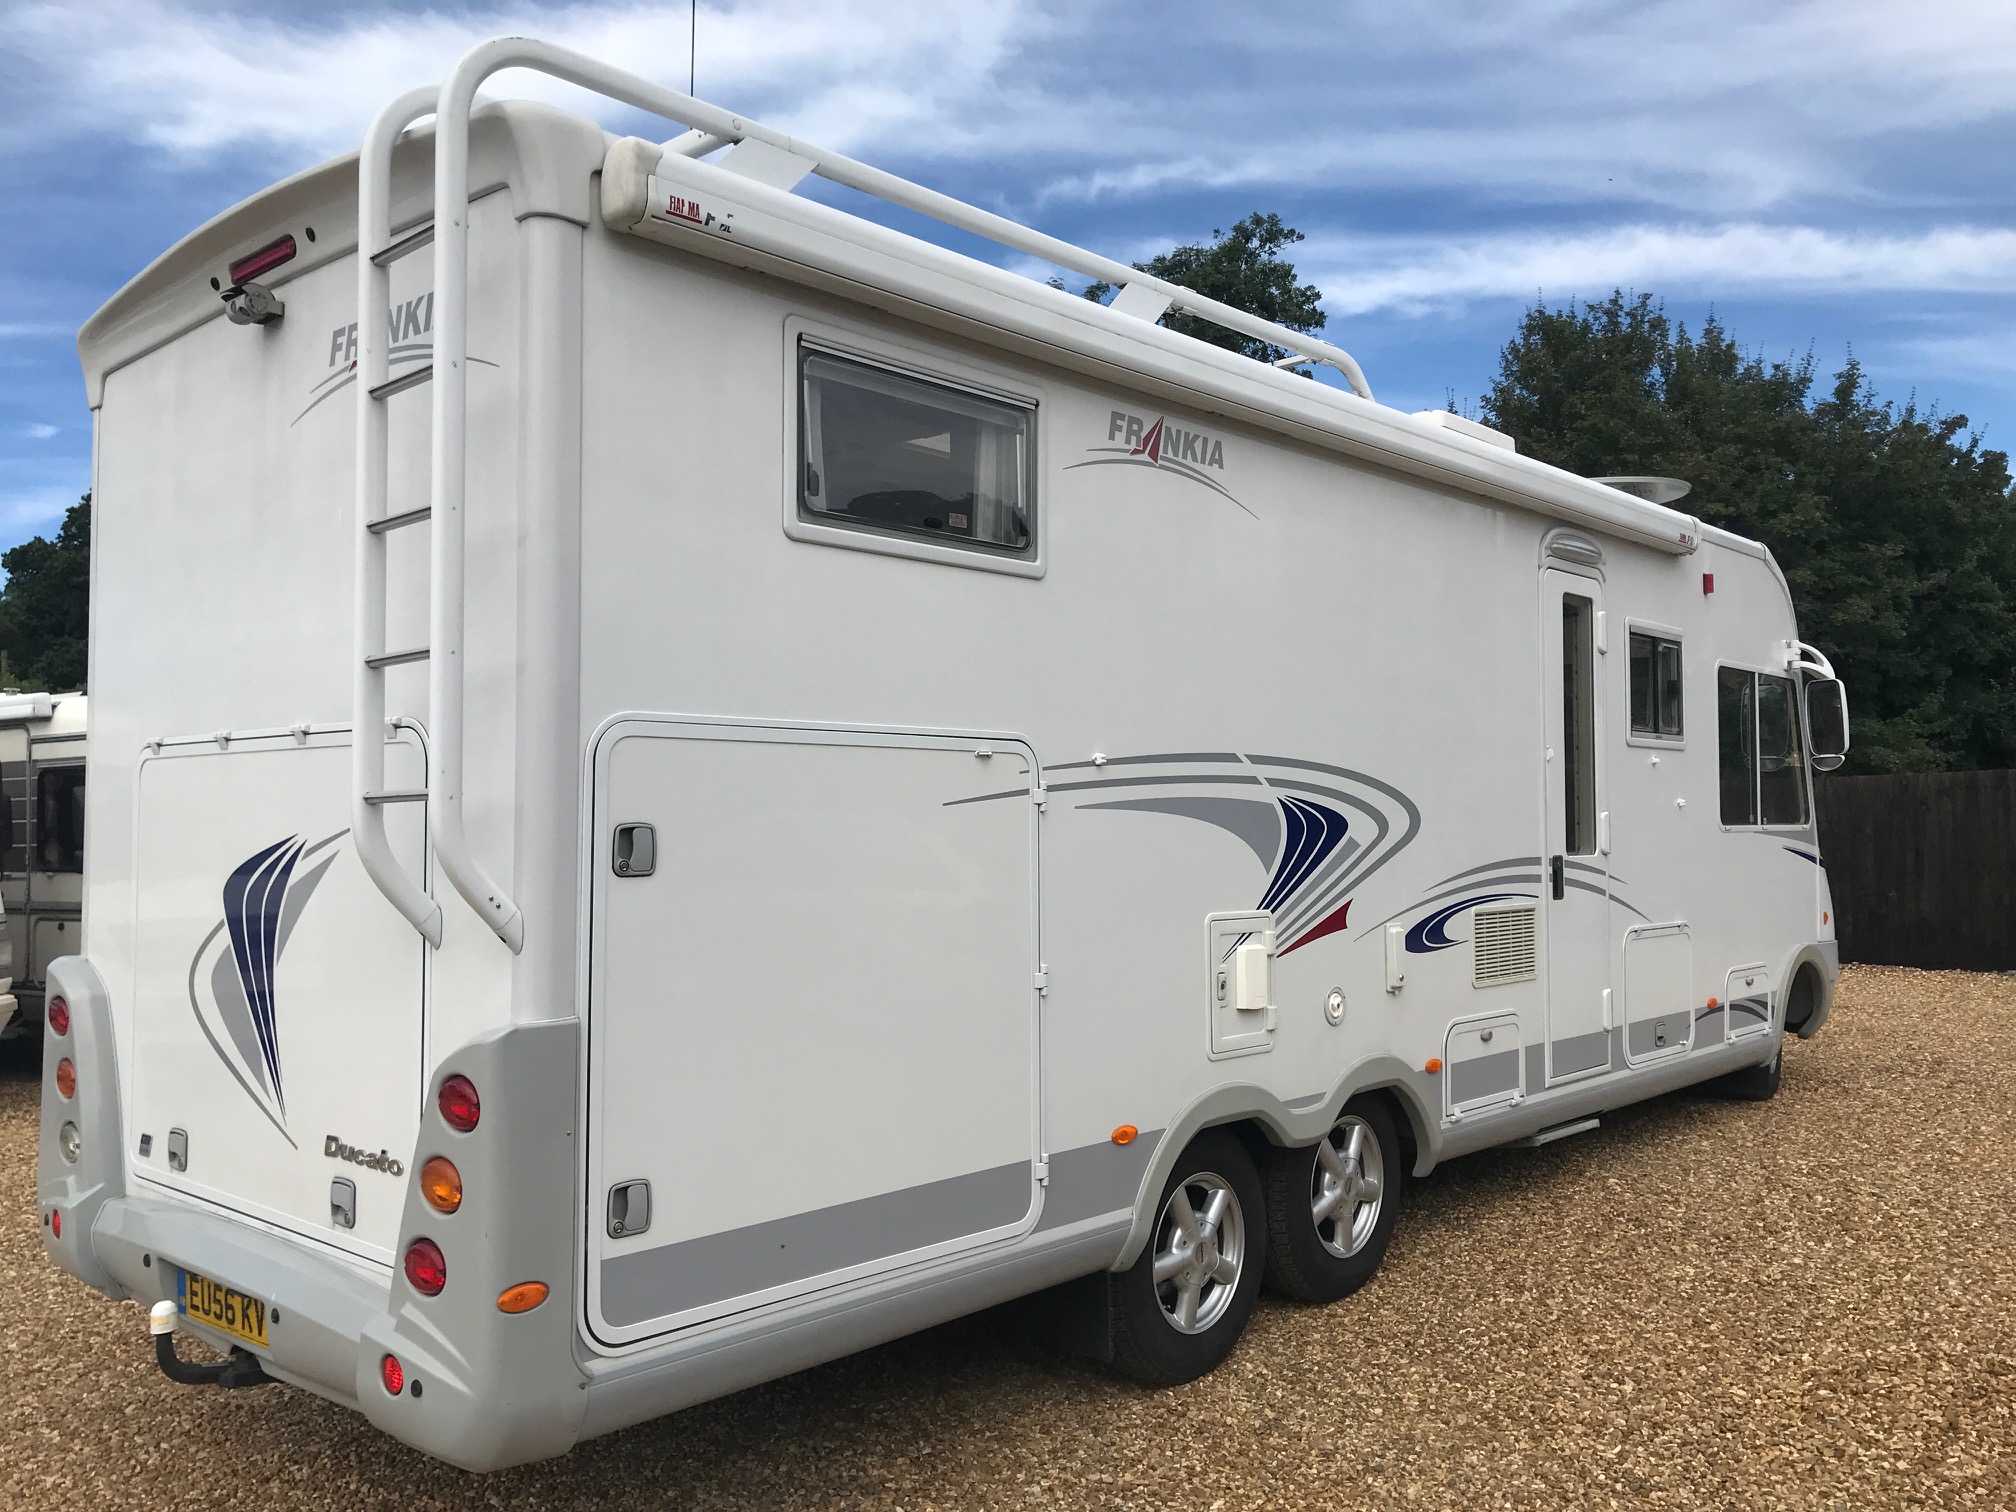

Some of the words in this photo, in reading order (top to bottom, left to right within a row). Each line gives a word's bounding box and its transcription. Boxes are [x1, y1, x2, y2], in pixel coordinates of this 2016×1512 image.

[329, 291, 434, 368] FRNKI
[1108, 410, 1225, 470] FRANKIA
[324, 1134, 405, 1177] Ducato
[188, 1272, 237, 1326] EU56
